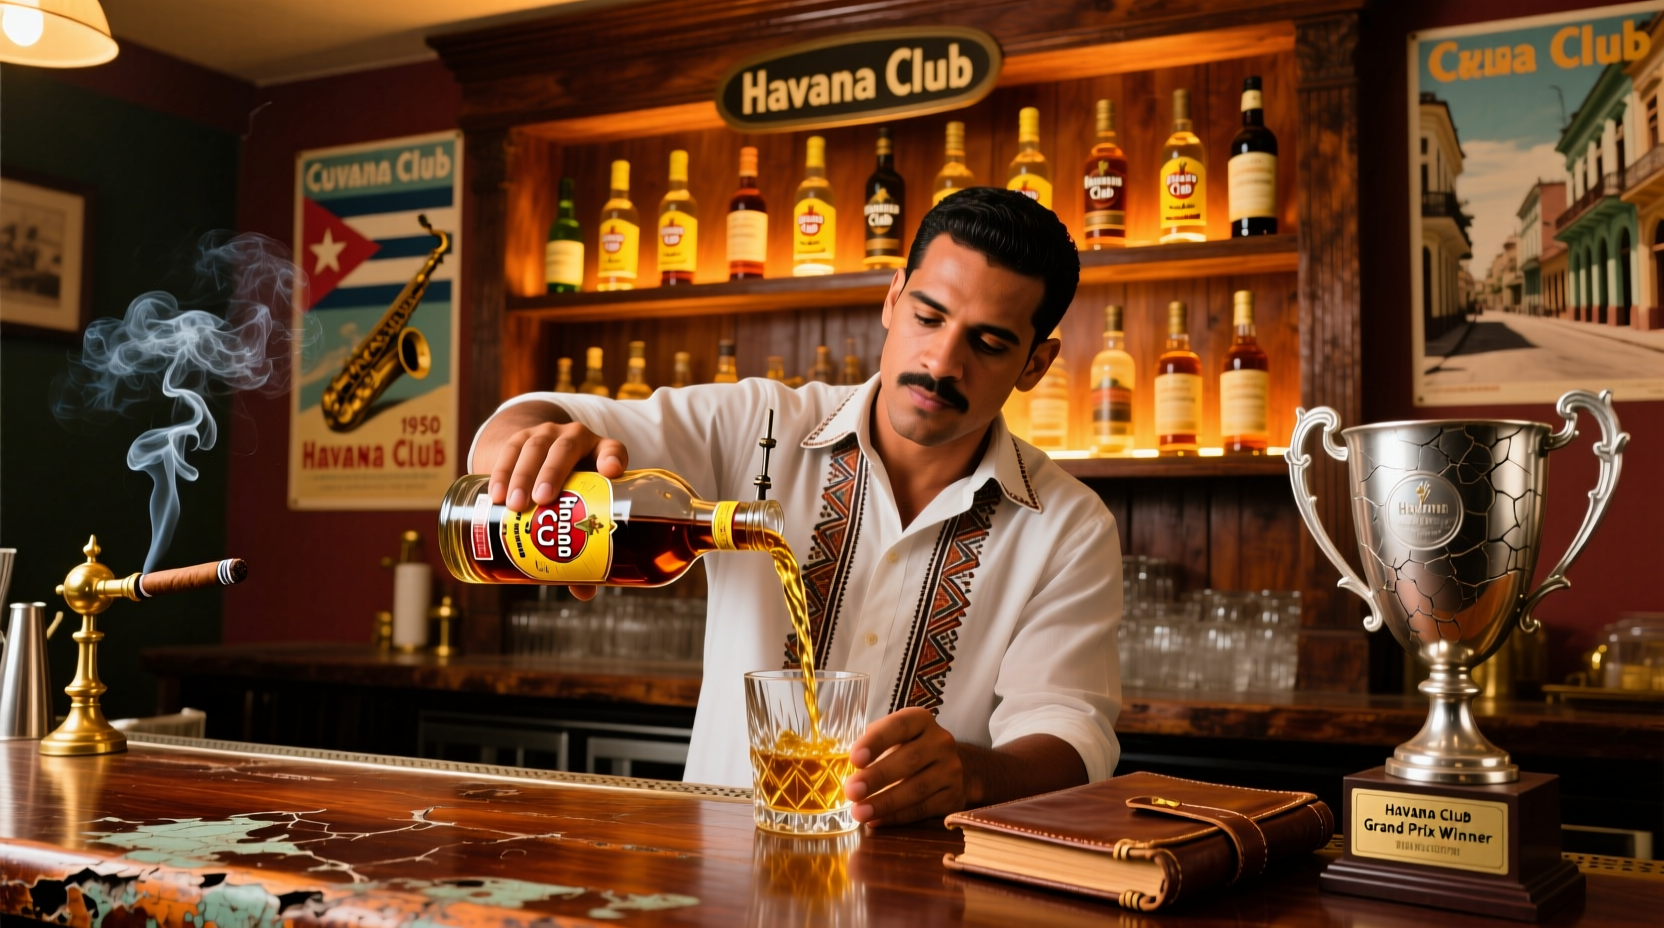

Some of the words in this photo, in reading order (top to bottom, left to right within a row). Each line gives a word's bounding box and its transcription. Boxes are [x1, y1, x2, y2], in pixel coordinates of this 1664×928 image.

[1549, 19, 1652, 70] Club
[742, 67, 876, 115] Havana
[885, 42, 973, 97] Club
[395, 146, 451, 183] Club
[401, 415, 441, 436] 1950
[1364, 818, 1404, 834] Grand
[1408, 822, 1436, 838] Prix
[1439, 826, 1493, 844] Winner
